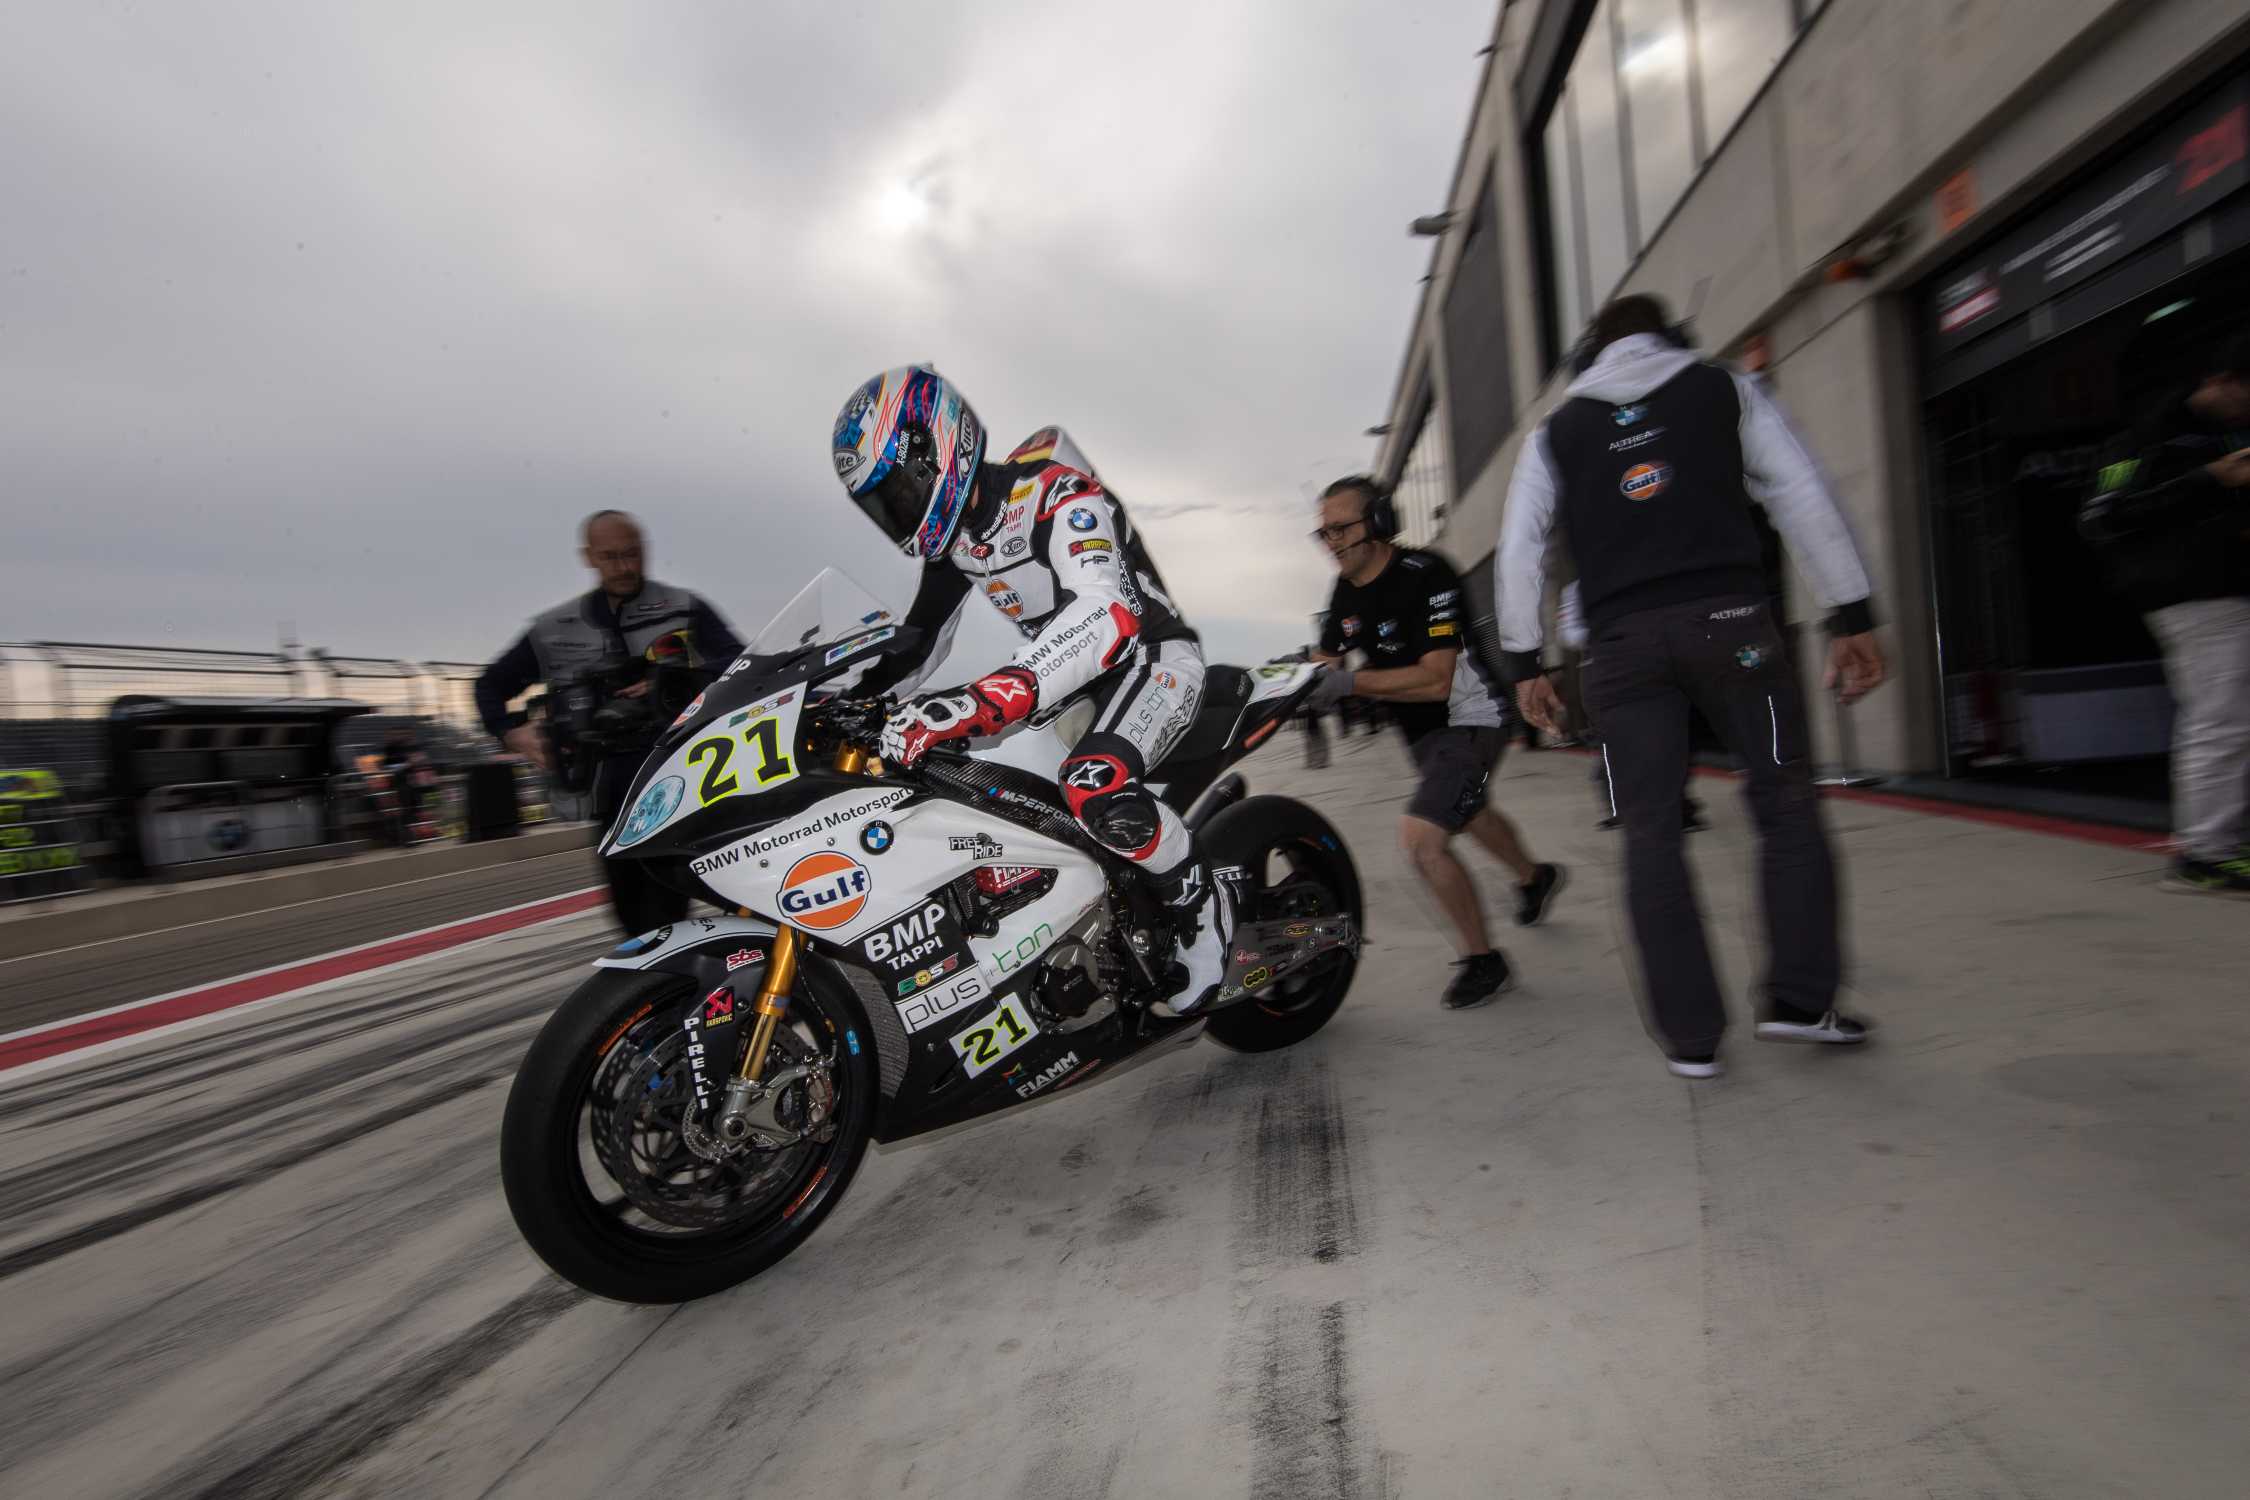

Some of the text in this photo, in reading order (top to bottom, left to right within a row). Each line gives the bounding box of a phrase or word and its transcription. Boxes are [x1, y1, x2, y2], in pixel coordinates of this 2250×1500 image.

[1624, 471, 1662, 493] Gulf
[1429, 592, 1452, 606] BMP
[1708, 606, 1755, 620] ALTHEA
[1051, 605, 1109, 649] Motorrad
[687, 717, 792, 808] 21
[692, 787, 912, 876] BMW Motorrad Motorsport
[974, 844, 1002, 860] RIDE
[781, 870, 866, 913] Gulf
[864, 903, 946, 963] BMP
[887, 936, 944, 971] TAPPI
[905, 977, 981, 1032] plus
[962, 1006, 1029, 1066] 21
[683, 1016, 710, 1111] PIRELLI
[1015, 1050, 1081, 1098] FIAMM
